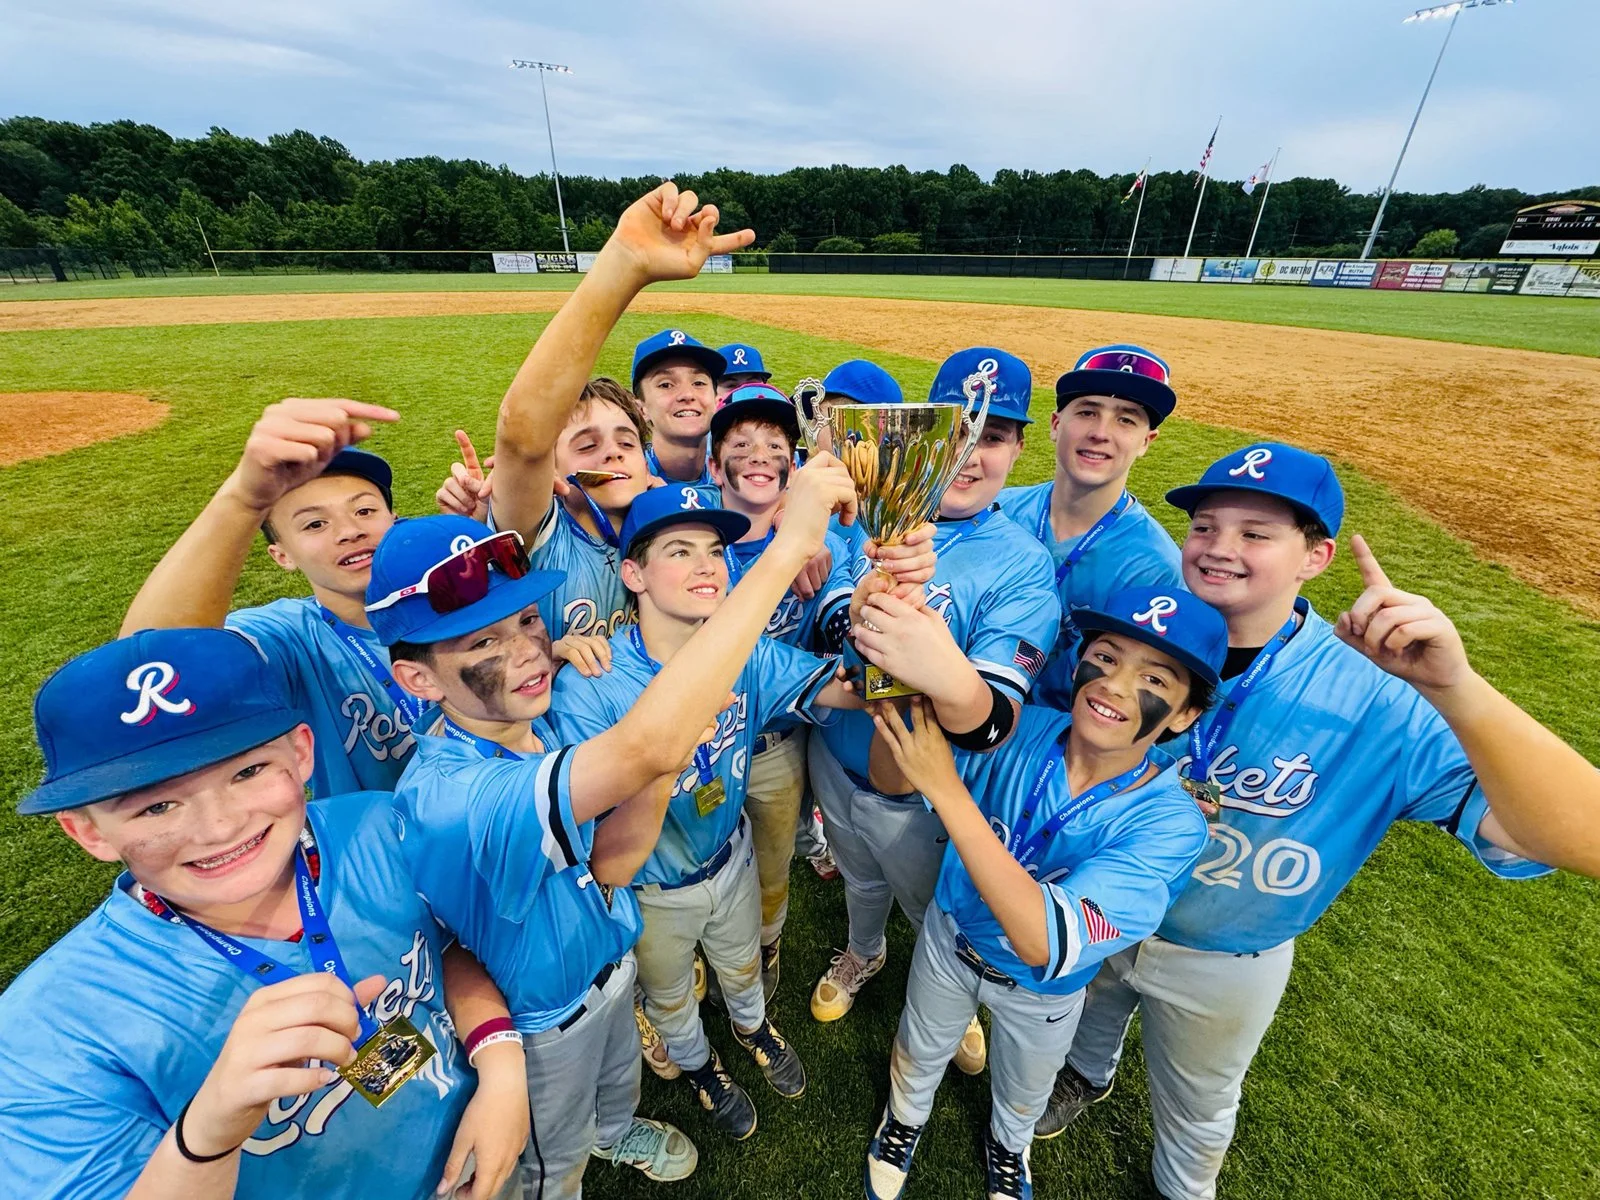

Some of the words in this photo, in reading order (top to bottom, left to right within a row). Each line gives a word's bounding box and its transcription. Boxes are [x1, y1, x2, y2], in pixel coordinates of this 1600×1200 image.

[537, 253, 576, 264] SIGNS
[1279, 266, 1289, 274] DC
[1290, 266, 1312, 275] METRO
[668, 330, 686, 346] R
[732, 348, 748, 365] R
[1228, 448, 1272, 482] R
[680, 487, 705, 510] R
[1132, 595, 1177, 636] R
[347, 635, 377, 668] Champions
[1241, 653, 1271, 688] Champions
[120, 661, 197, 727] R
[1193, 721, 1202, 760] hampions
[1034, 760, 1055, 797] Champions
[1180, 744, 1320, 818] kets
[1059, 794, 1095, 822] Champions
[1191, 823, 1321, 897] 20
[301, 875, 317, 917] Champions
